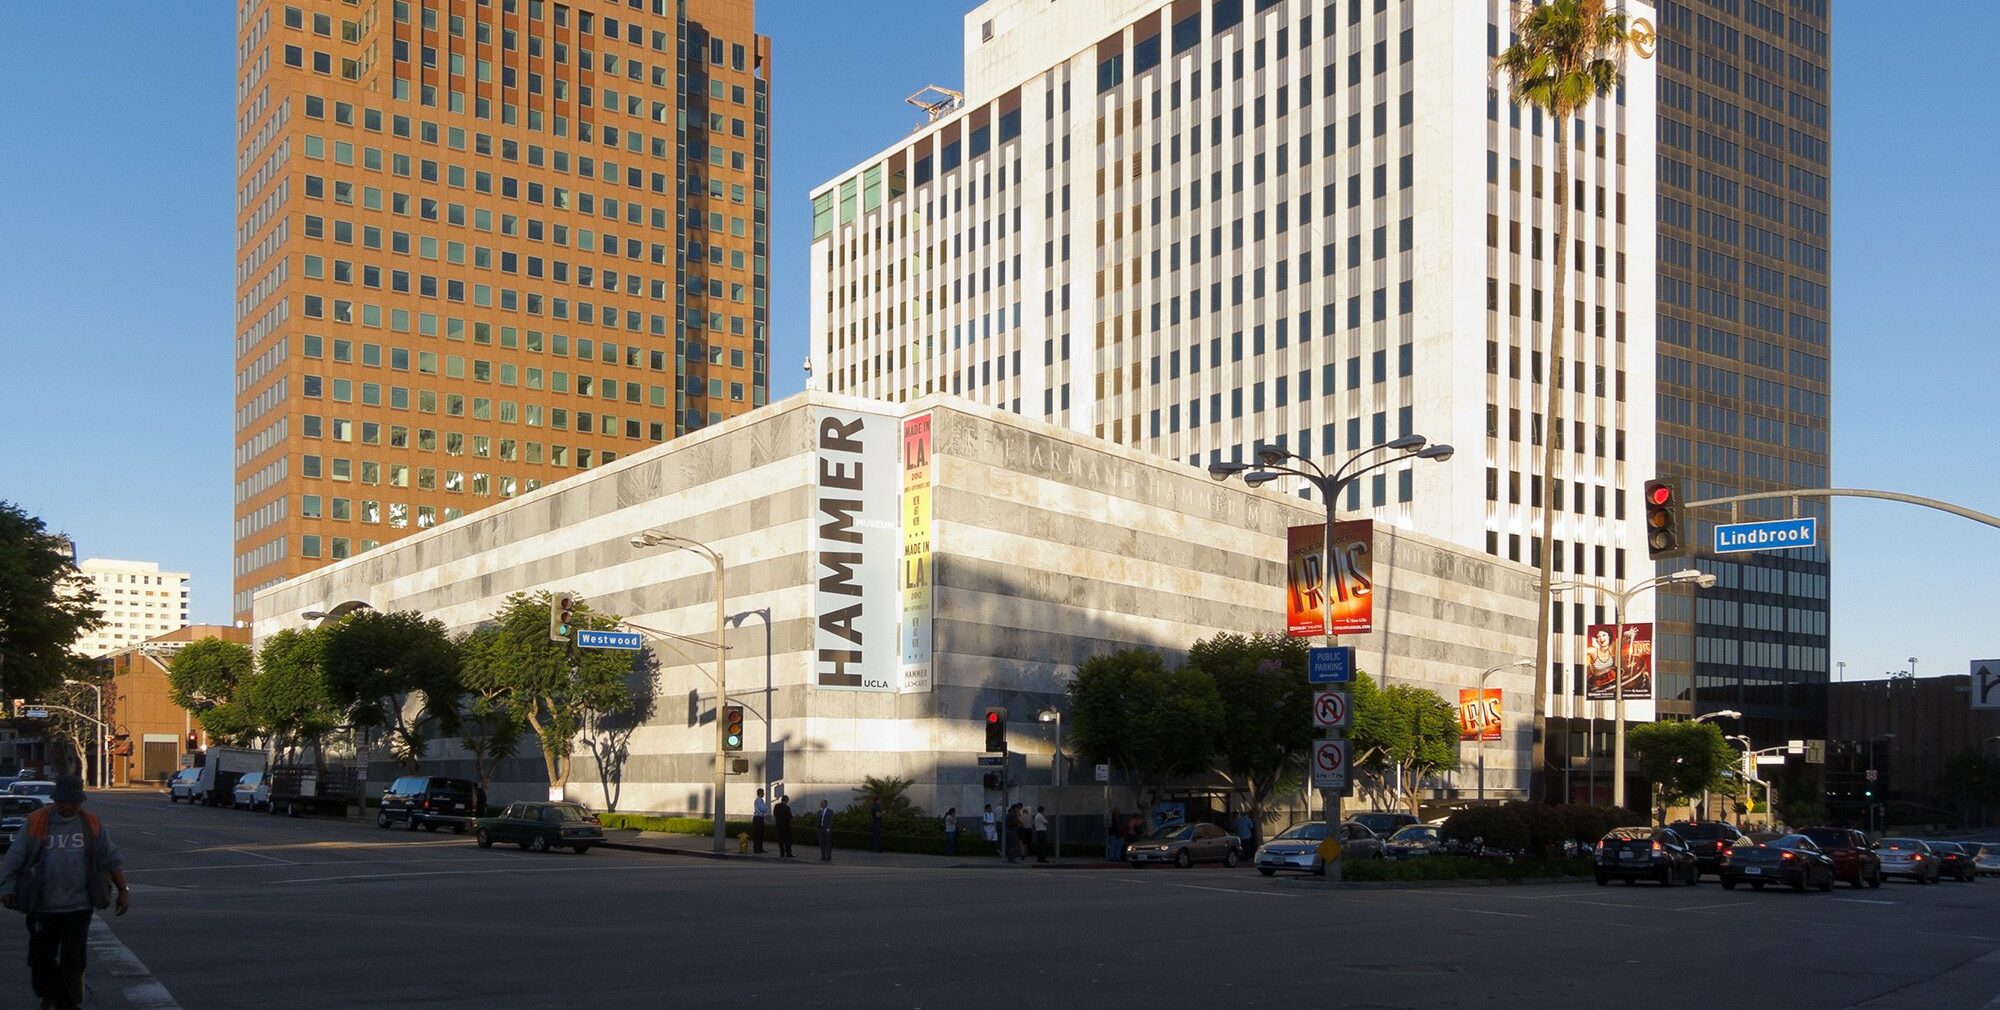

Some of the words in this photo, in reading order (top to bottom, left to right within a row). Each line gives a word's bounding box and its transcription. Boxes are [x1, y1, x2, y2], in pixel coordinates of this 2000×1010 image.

[904, 422, 921, 438] MADE
[923, 420, 931, 433] IN
[906, 438, 928, 470] L.A.
[1032, 444, 1136, 491] ARMAND
[1150, 479, 1236, 516] HAMMER
[855, 518, 895, 530] MUSEUM
[1720, 525, 1810, 546] Lindbrook
[818, 416, 865, 687] HAMMER
[904, 542, 921, 556] MADE
[922, 540, 930, 553] IN
[906, 557, 928, 590] L.A.
[1288, 541, 1373, 616] IRIS
[582, 634, 637, 646] Westwood
[1316, 652, 1341, 661] PUBLIC
[904, 669, 928, 679] HAMMER
[1314, 663, 1343, 672] PARKING
[864, 680, 889, 688] UCLA
[1460, 698, 1502, 731] IRIS
